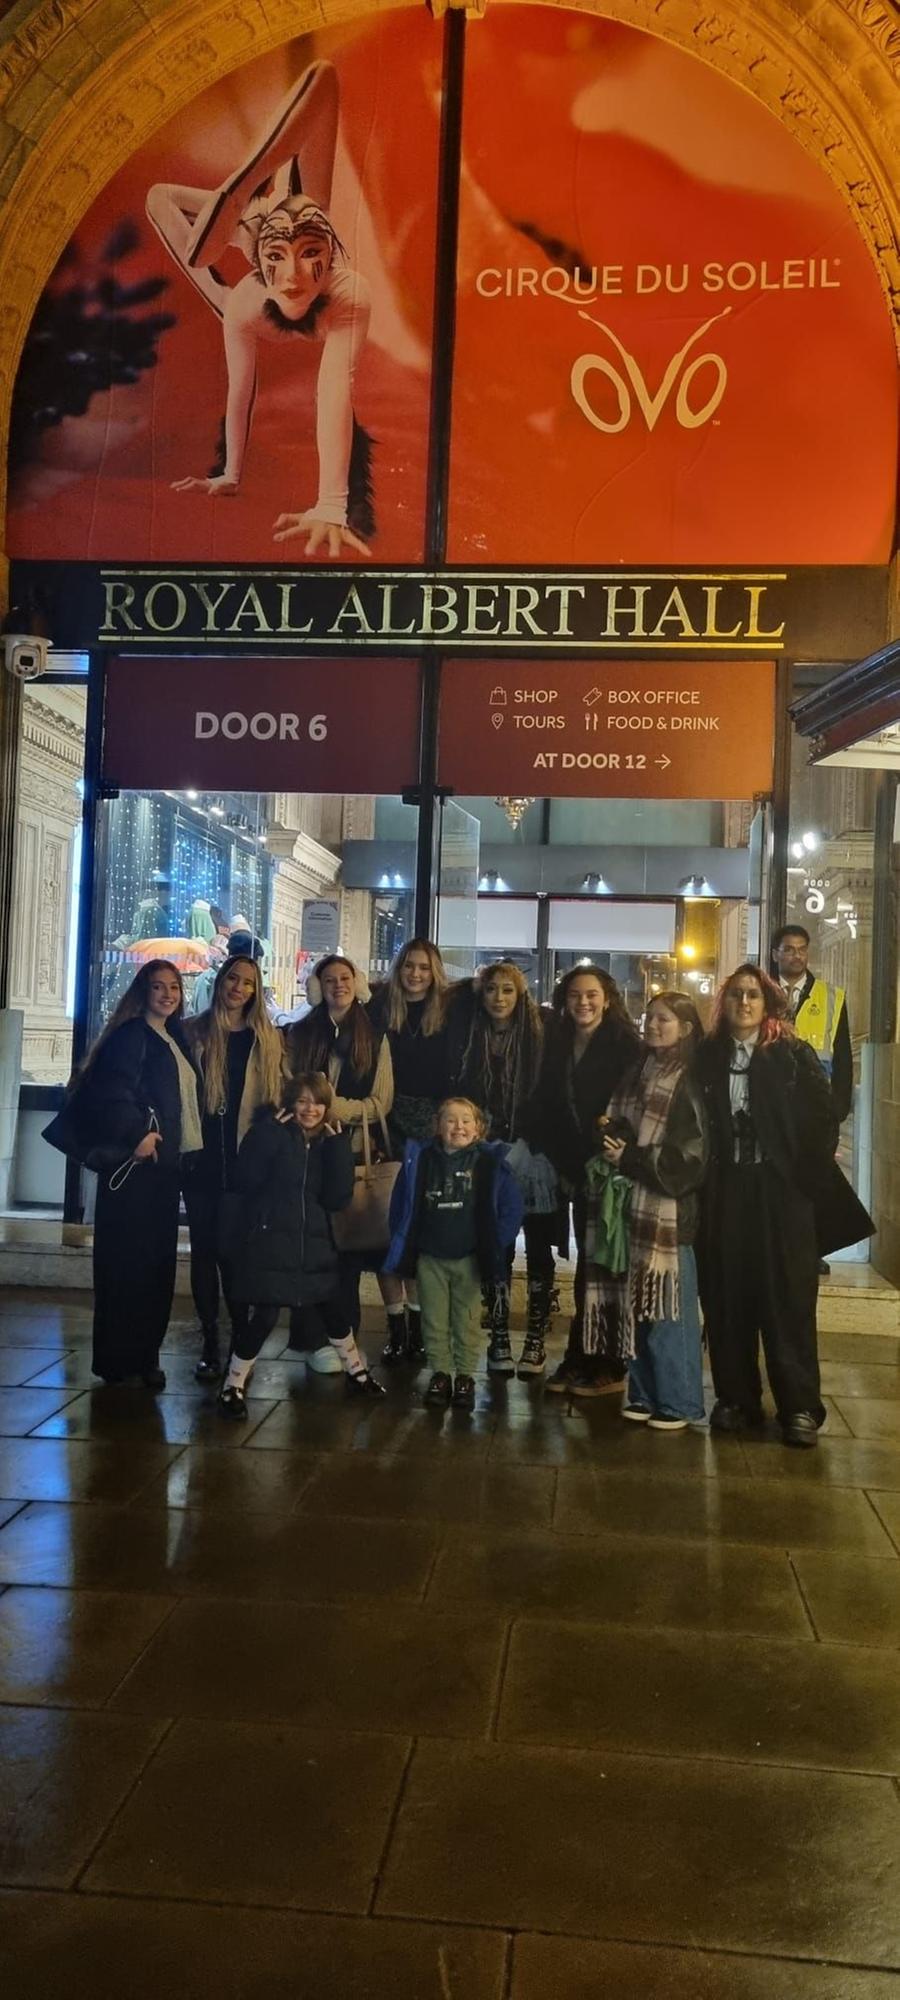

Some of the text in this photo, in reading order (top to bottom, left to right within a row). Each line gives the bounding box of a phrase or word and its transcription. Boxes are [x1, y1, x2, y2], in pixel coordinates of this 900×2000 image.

[476, 265, 624, 304] CIRQUE
[636, 263, 690, 294] DU
[571, 306, 732, 433] OVO
[98, 582, 786, 638] ROYAL ALBERT HALL
[513, 689, 559, 704] SHOP
[608, 690, 701, 705] BOX OFFICE
[194, 711, 329, 742] DOOR 6
[513, 714, 566, 730] TOURS
[607, 716, 720, 731] FOOD & DRINK
[533, 753, 647, 770] AT DOOR 12
